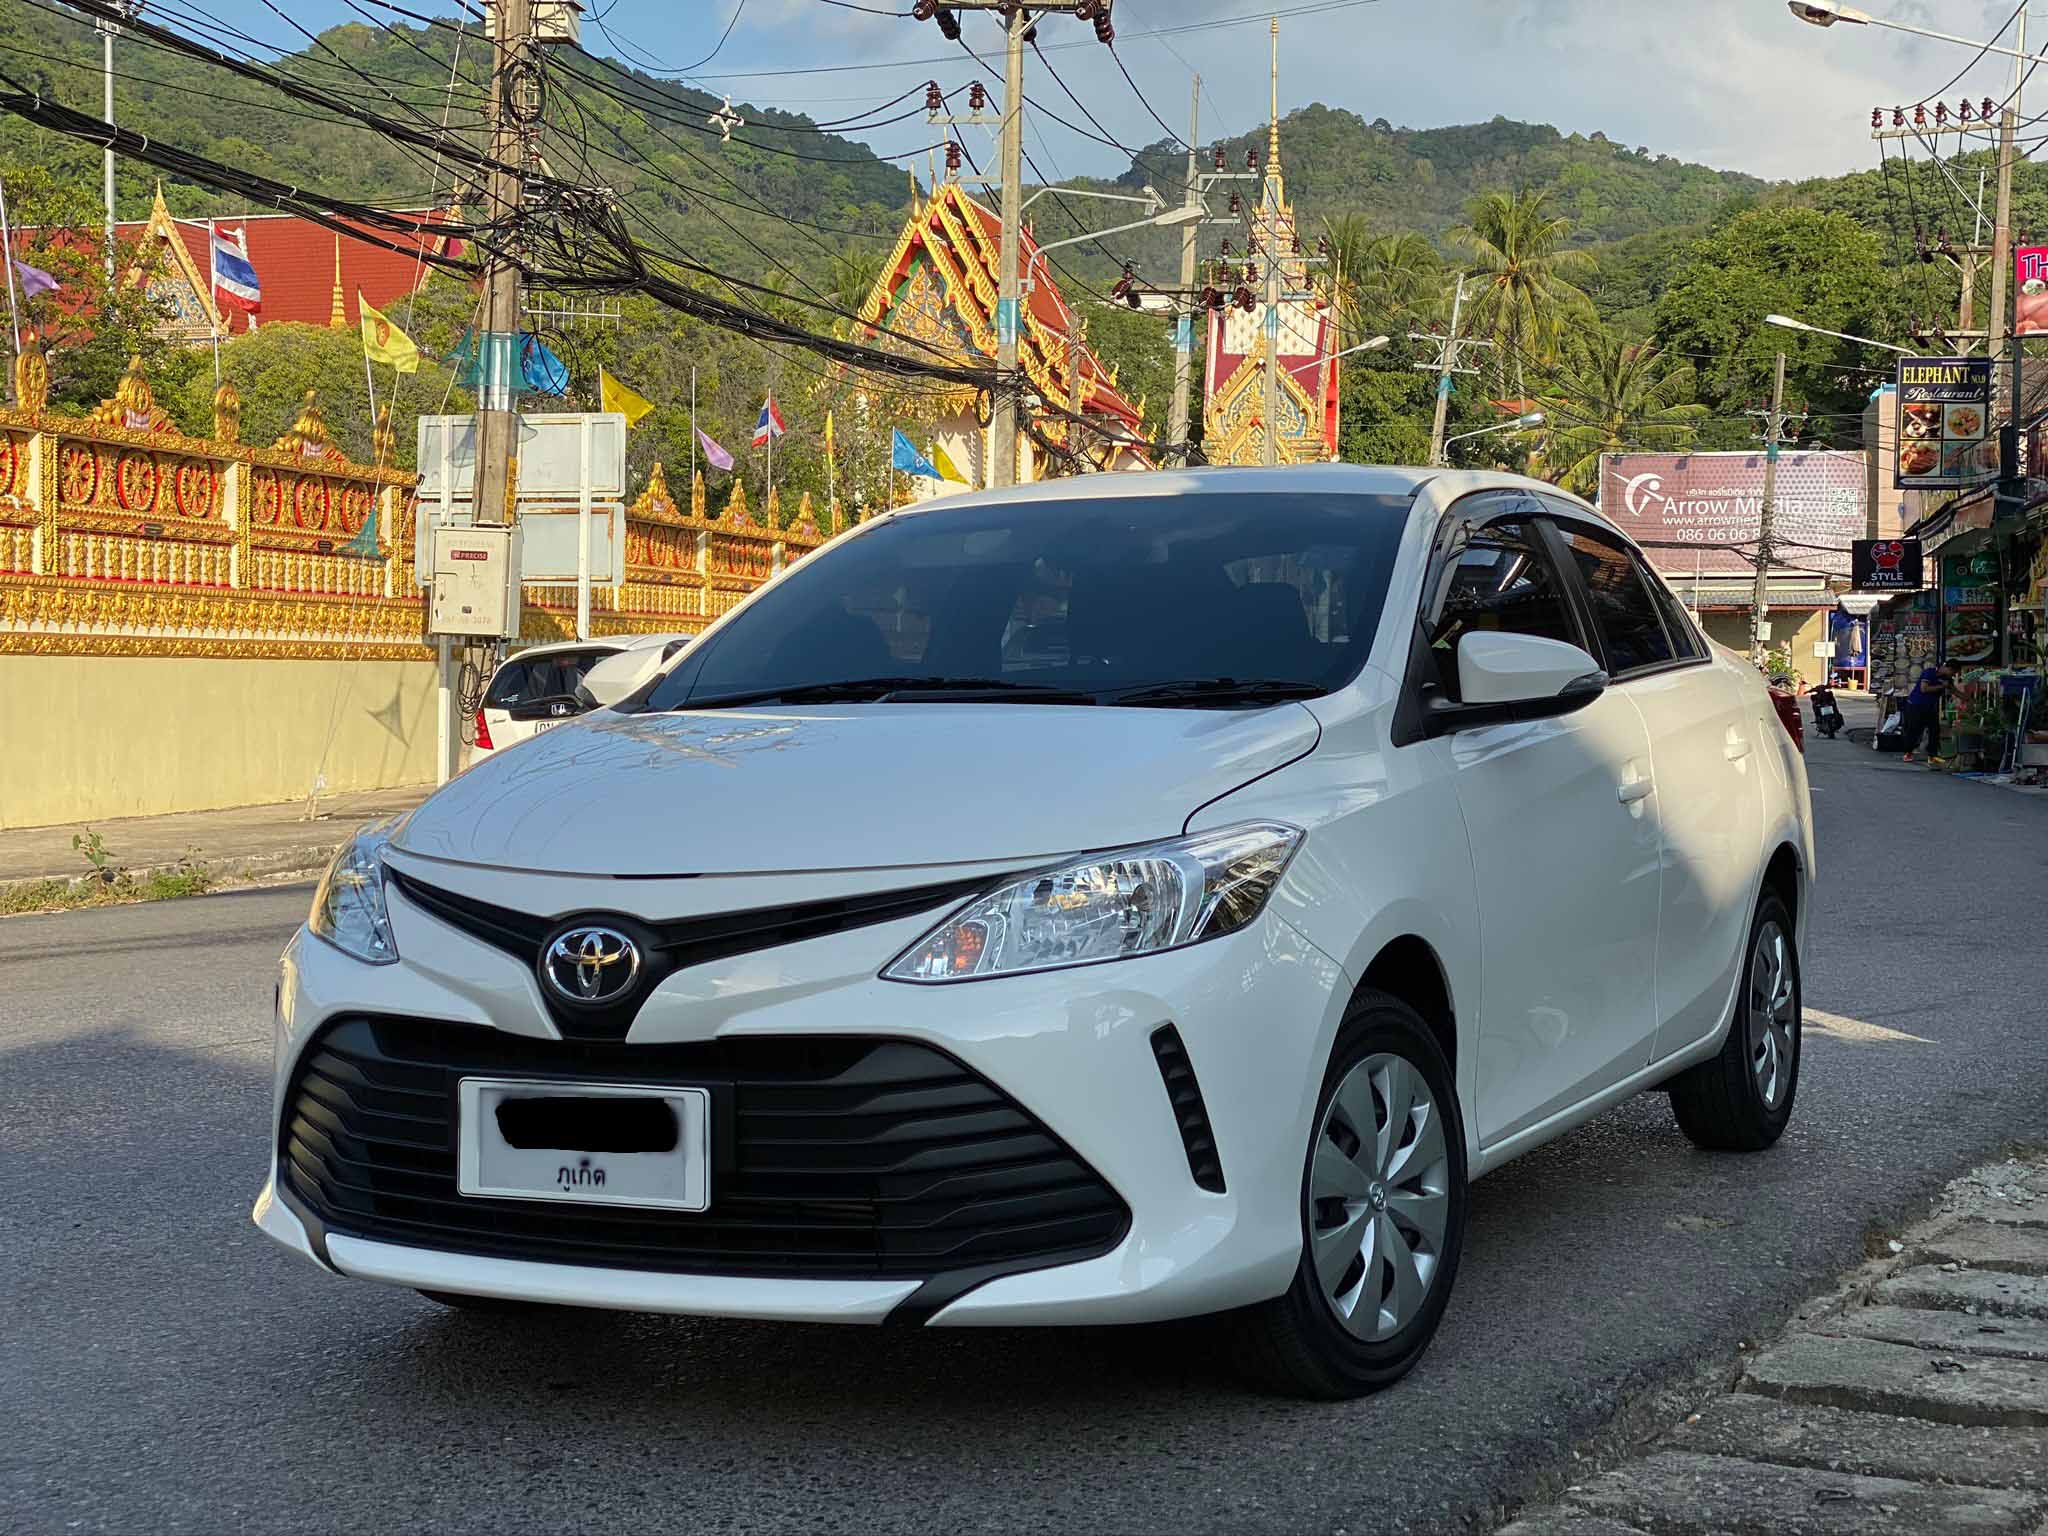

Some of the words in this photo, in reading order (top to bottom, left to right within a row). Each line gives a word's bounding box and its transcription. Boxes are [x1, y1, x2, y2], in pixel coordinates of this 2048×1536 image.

[1902, 366, 1969, 384] ELEPHANT
[1662, 496, 1728, 515] Arrow
[1676, 528, 1704, 541] 086
[1707, 528, 1726, 541] 06
[1729, 528, 1748, 541] 06
[1871, 572, 1903, 581] STYLE
